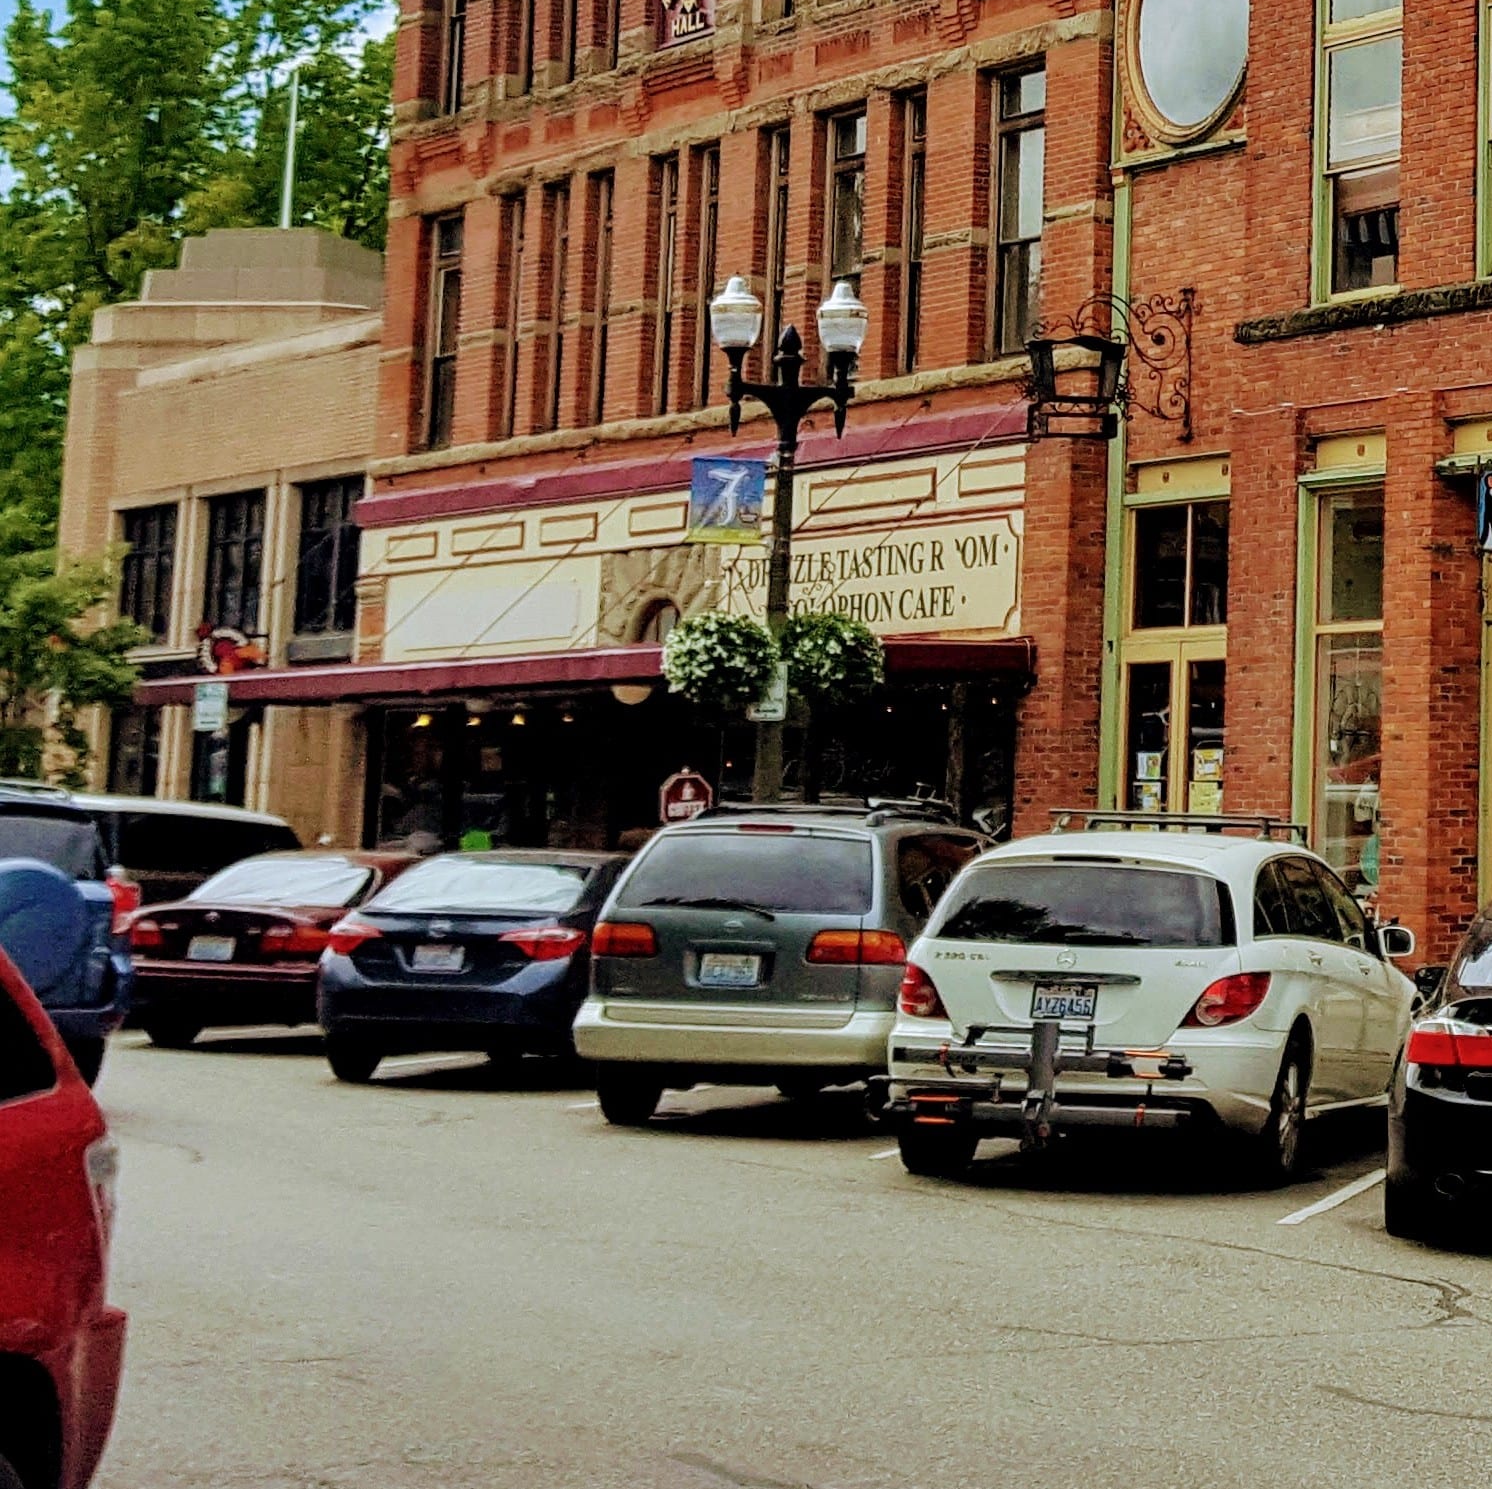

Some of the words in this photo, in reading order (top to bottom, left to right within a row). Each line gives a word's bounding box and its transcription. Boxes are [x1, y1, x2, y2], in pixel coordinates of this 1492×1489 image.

[672, 11, 705, 36] HALL
[748, 551, 831, 589] DZLE
[836, 538, 927, 581] TASTING
[930, 533, 1000, 572] ROM
[900, 585, 956, 622] CAFE
